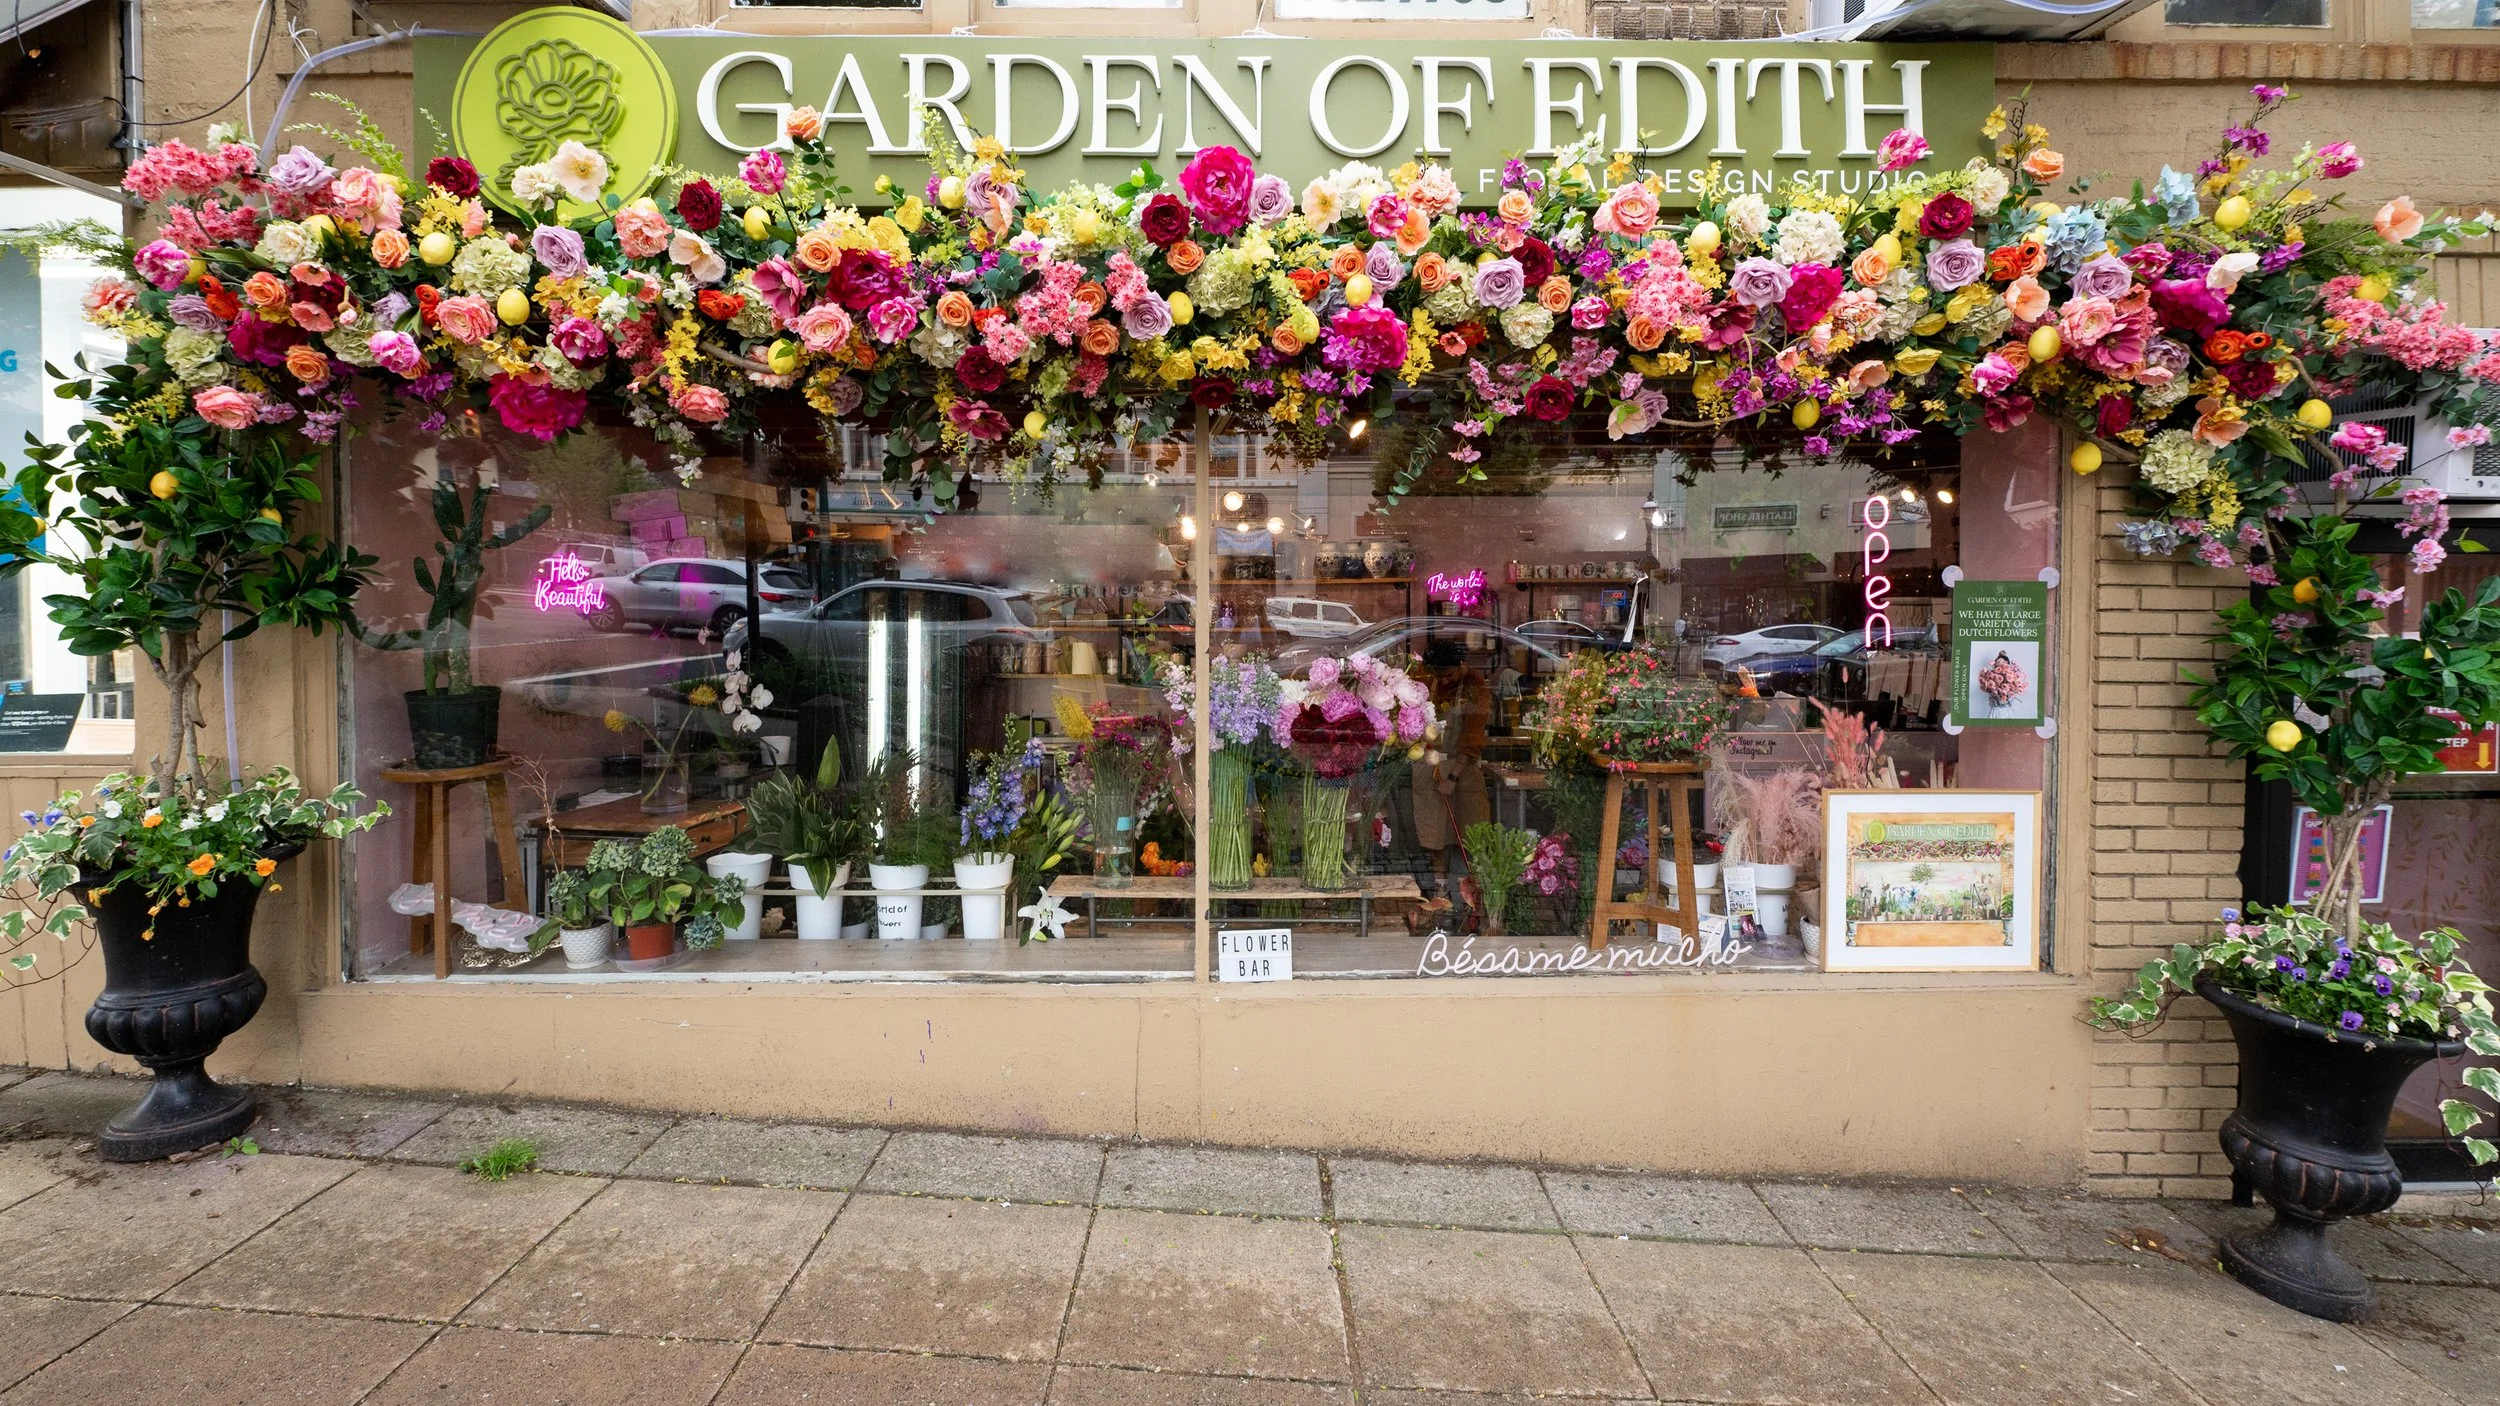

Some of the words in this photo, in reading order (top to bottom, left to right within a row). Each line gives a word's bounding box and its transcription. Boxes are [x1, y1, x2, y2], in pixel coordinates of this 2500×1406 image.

[696, 50, 1272, 157] GARDEN
[1308, 54, 1494, 158] OF
[1522, 56, 1934, 160] EDITH
[550, 552, 590, 584] Hello
[1863, 495, 1892, 648] open
[1427, 572, 1450, 593] The
[535, 579, 604, 614] Beautiful
[1958, 610, 1974, 619] WE
[1975, 610, 2001, 619] HAVE
[2002, 610, 2009, 619] A
[2011, 610, 2041, 619] LARGE
[1973, 619, 2012, 628] VARIETY
[2013, 619, 2026, 628] OF
[1959, 628, 1992, 637] DUTCH
[1994, 628, 2038, 637] FLOWERS
[1887, 825, 1936, 837] GARDEN
[1937, 825, 1953, 837] OF
[1955, 825, 1989, 837] EDITH
[1221, 934, 1289, 953] FLOWER
[1416, 931, 1602, 976] Bésame
[1604, 921, 1753, 969] mucho
[1238, 959, 1270, 977] BAR
